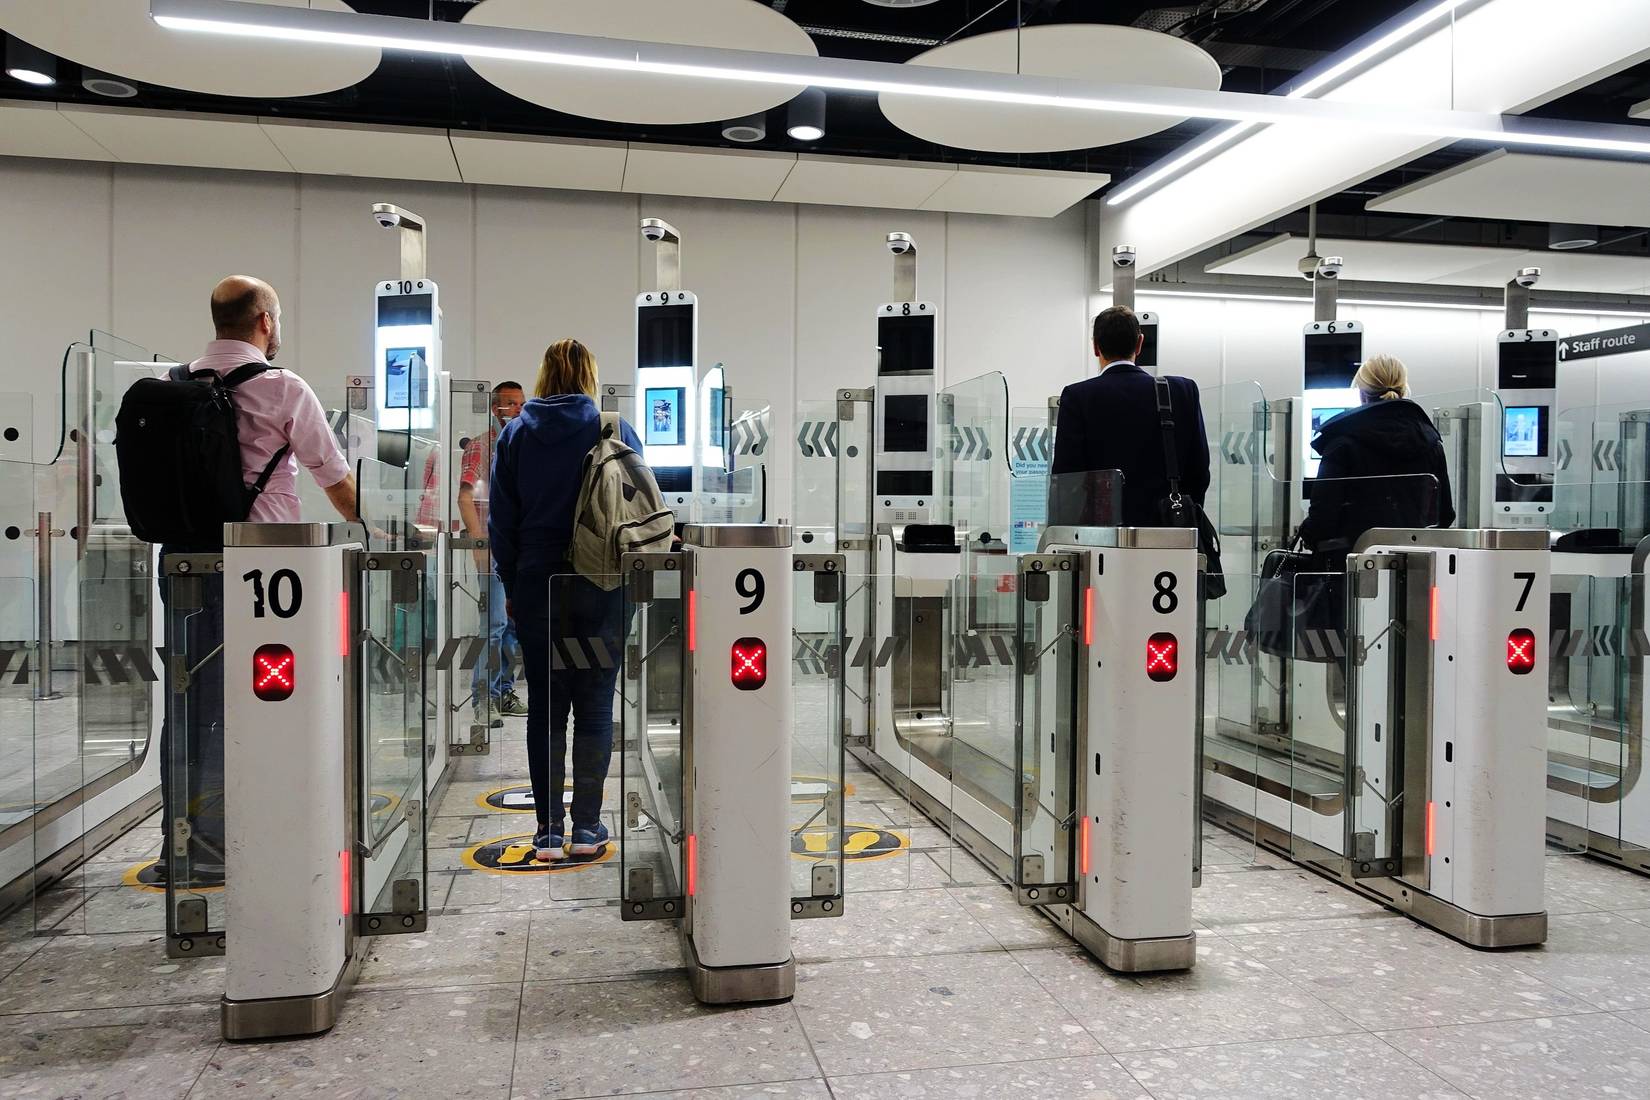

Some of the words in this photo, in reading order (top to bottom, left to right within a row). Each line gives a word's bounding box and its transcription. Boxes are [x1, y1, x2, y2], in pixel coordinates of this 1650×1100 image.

[397, 280, 412, 294] 10
[660, 292, 669, 305] 9
[902, 303, 910, 315] 8
[1327, 321, 1336, 334] 6
[1525, 330, 1533, 342] 5
[1572, 337, 1600, 353] Staff
[1602, 334, 1636, 349] route
[242, 568, 303, 619] 10
[734, 567, 766, 615] 9
[1152, 570, 1179, 614] 8
[1514, 572, 1536, 612] 7
